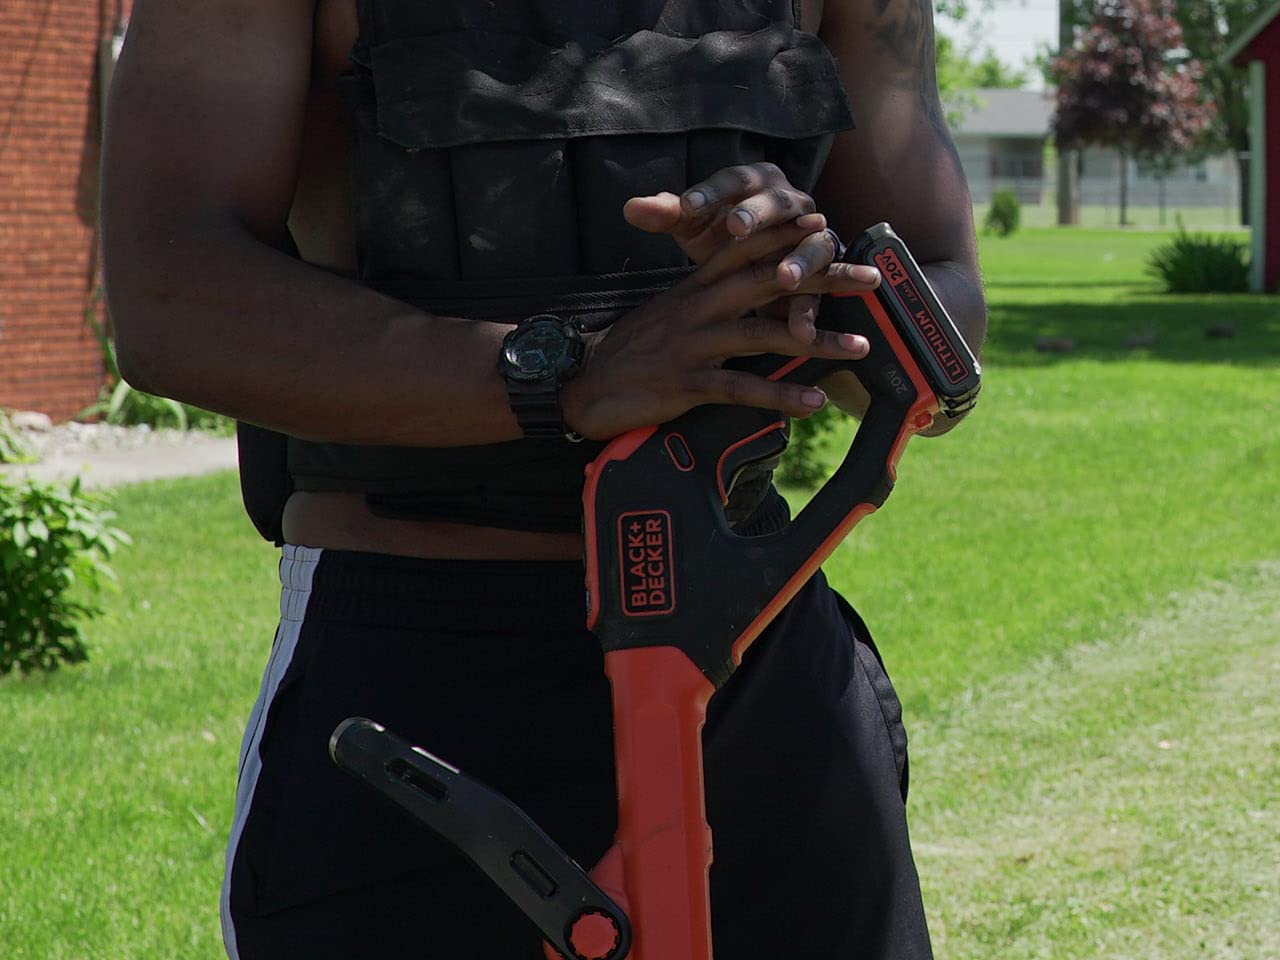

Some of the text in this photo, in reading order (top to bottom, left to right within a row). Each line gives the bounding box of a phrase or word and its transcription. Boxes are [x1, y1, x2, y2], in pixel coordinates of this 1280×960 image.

[915, 310, 960, 381] LITHIUM
[628, 521, 647, 606] BLACK+
[646, 519, 666, 605] DECKER
